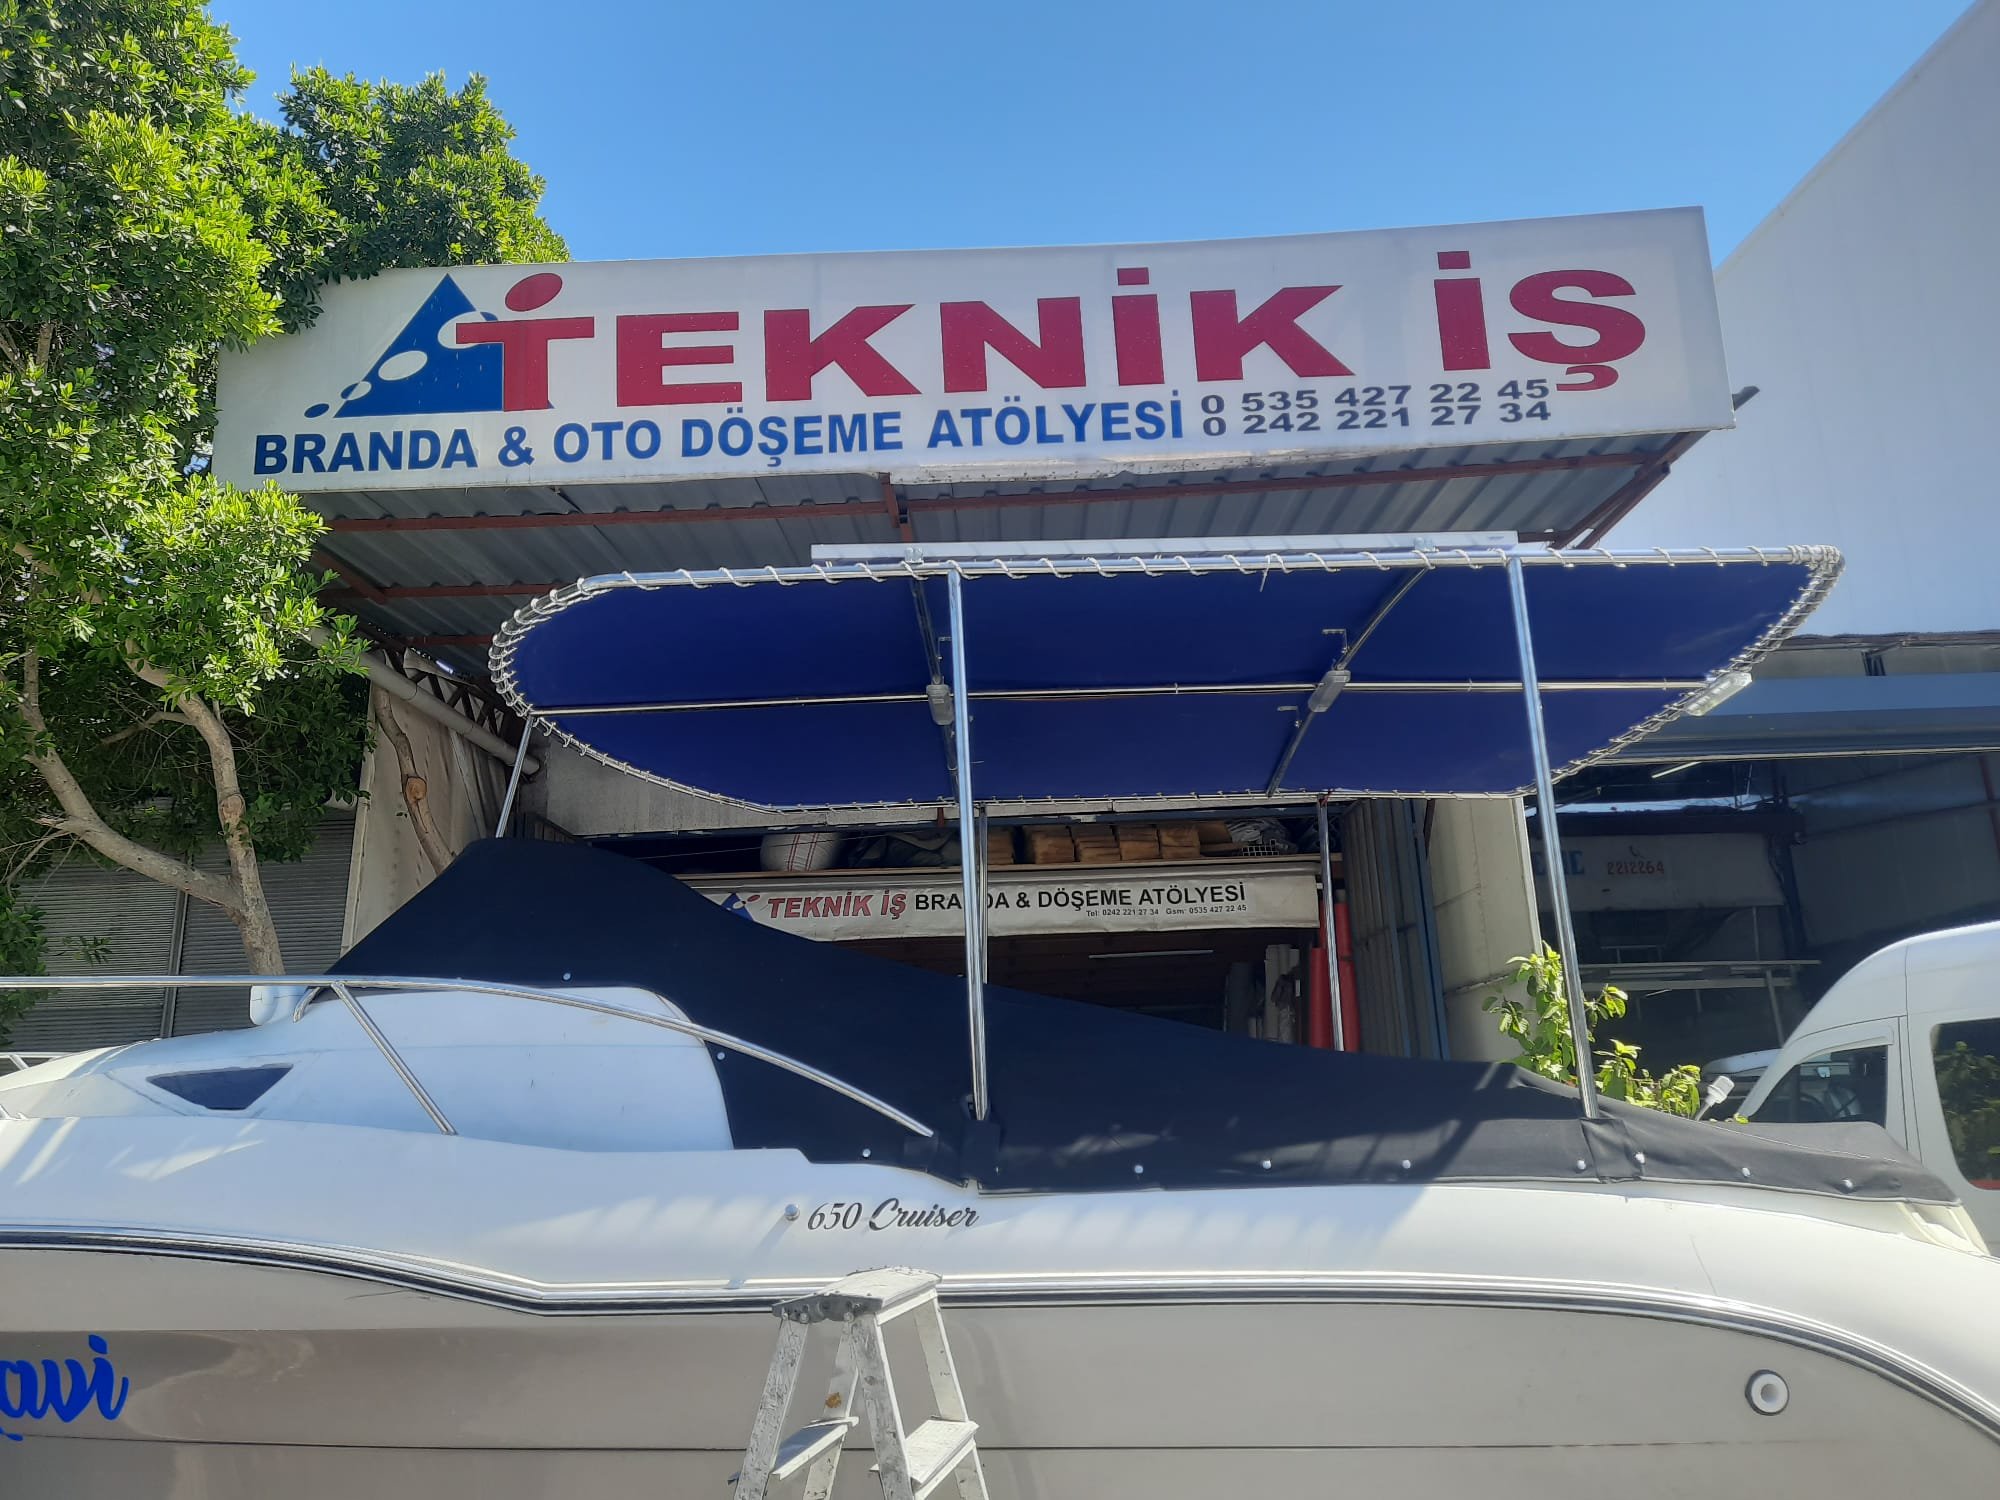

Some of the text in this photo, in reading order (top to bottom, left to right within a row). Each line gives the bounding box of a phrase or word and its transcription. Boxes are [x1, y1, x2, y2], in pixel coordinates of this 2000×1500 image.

[456, 250, 1647, 412] TEKNİK İŞ
[1200, 378, 1550, 415] 0 535 427 22 45
[254, 390, 1184, 475] BRANDA & OTO DÖŞEME ATÖLYESİ
[1202, 400, 1552, 437] 0 242 221 27 34
[1607, 860, 1665, 876] 2212264
[768, 889, 907, 920] TEKNİK İŞ
[915, 882, 1246, 912] BRAA & DÖŞEME ATÖLYESİ
[1102, 908, 1121, 917] 0242
[1122, 908, 1137, 917] 221
[1138, 908, 1148, 916] 27
[1149, 908, 1160, 916] 34
[1188, 906, 1208, 915] 0535
[1209, 905, 1224, 914] 427
[1225, 904, 1236, 913] 22
[1236, 903, 1248, 912] 45
[807, 1197, 980, 1232] 650 Cruiser
[0, 1333, 131, 1442] avi
